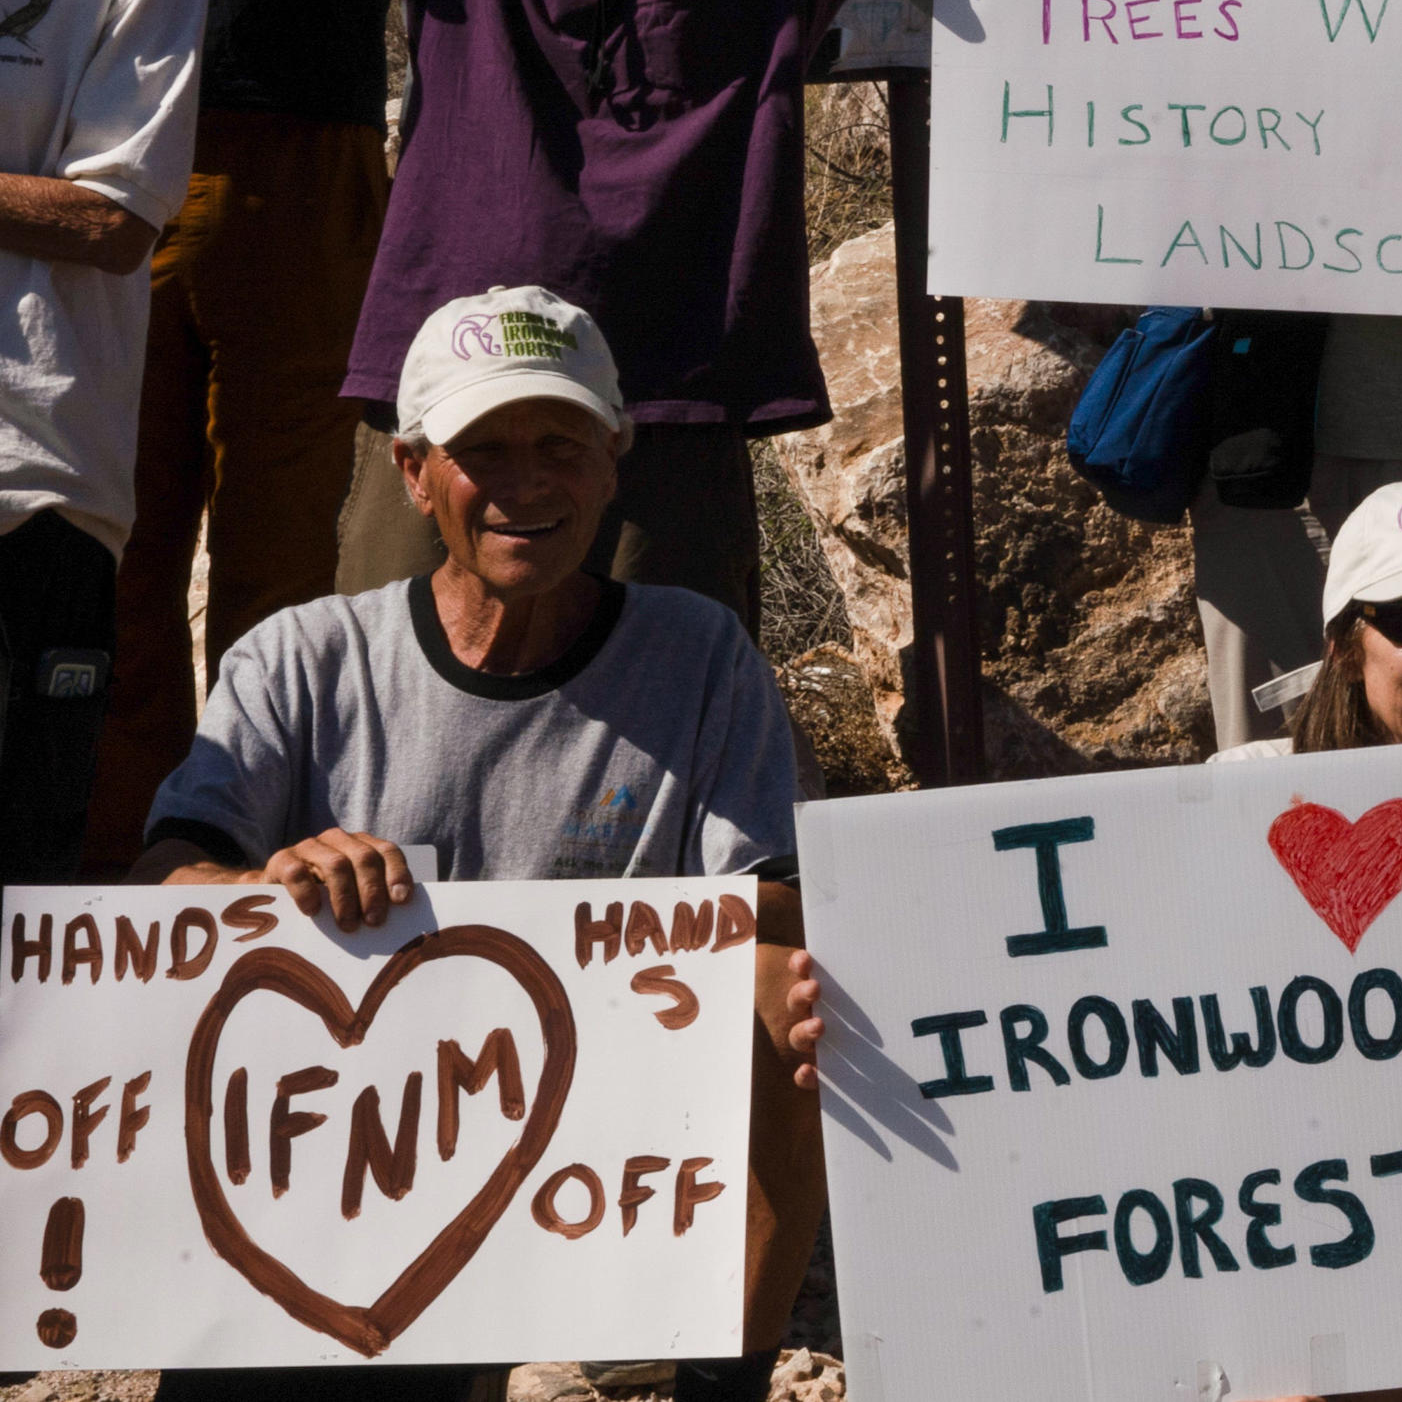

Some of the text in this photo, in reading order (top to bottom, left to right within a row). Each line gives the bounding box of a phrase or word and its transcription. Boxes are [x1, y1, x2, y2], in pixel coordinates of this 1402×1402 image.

[1000, 80, 1325, 157] HISTORY
[11, 894, 281, 986] HANDS
[991, 815, 1108, 957] I
[0, 1070, 726, 1240] OFF OFF
[224, 1028, 526, 1220] IFNM
